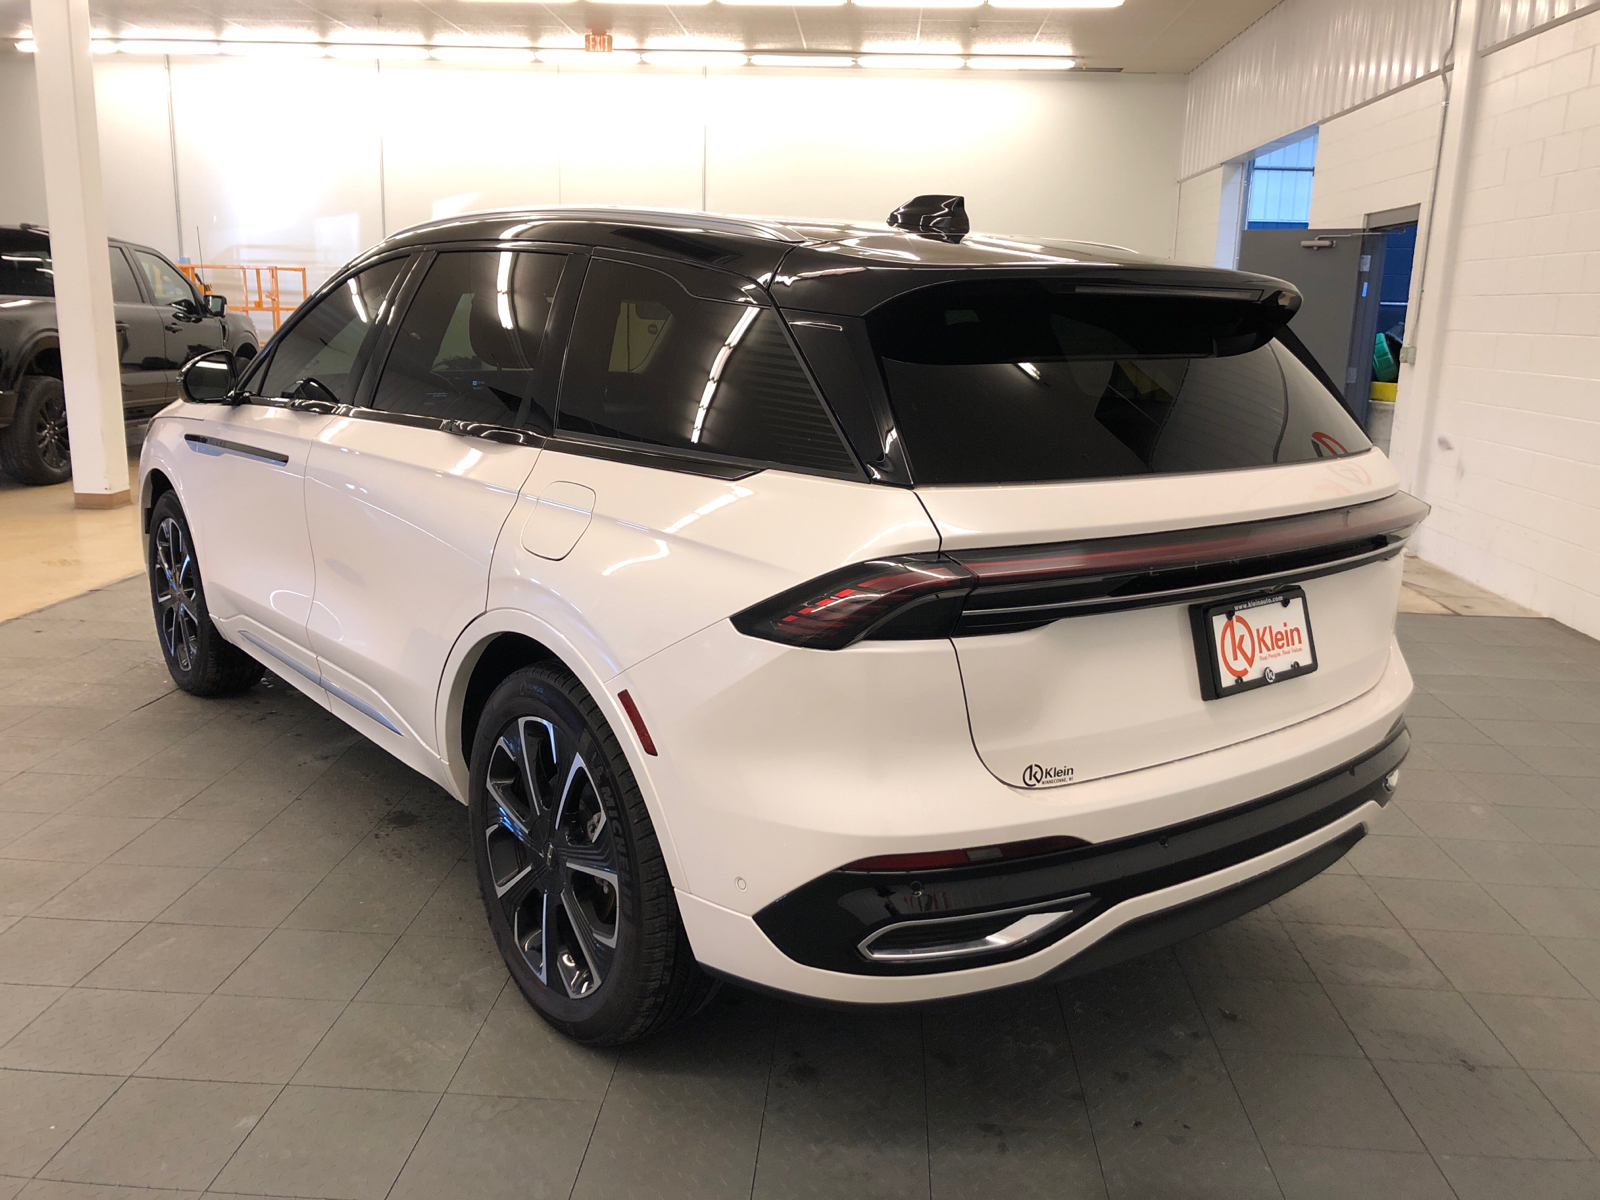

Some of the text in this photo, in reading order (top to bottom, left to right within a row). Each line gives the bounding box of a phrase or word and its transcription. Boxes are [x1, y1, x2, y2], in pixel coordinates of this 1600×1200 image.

[590, 35, 609, 52] EXIT
[1234, 595, 1283, 611] www.kleinauto.com
[1256, 622, 1302, 653] Klein
[1045, 766, 1074, 779] Klein
